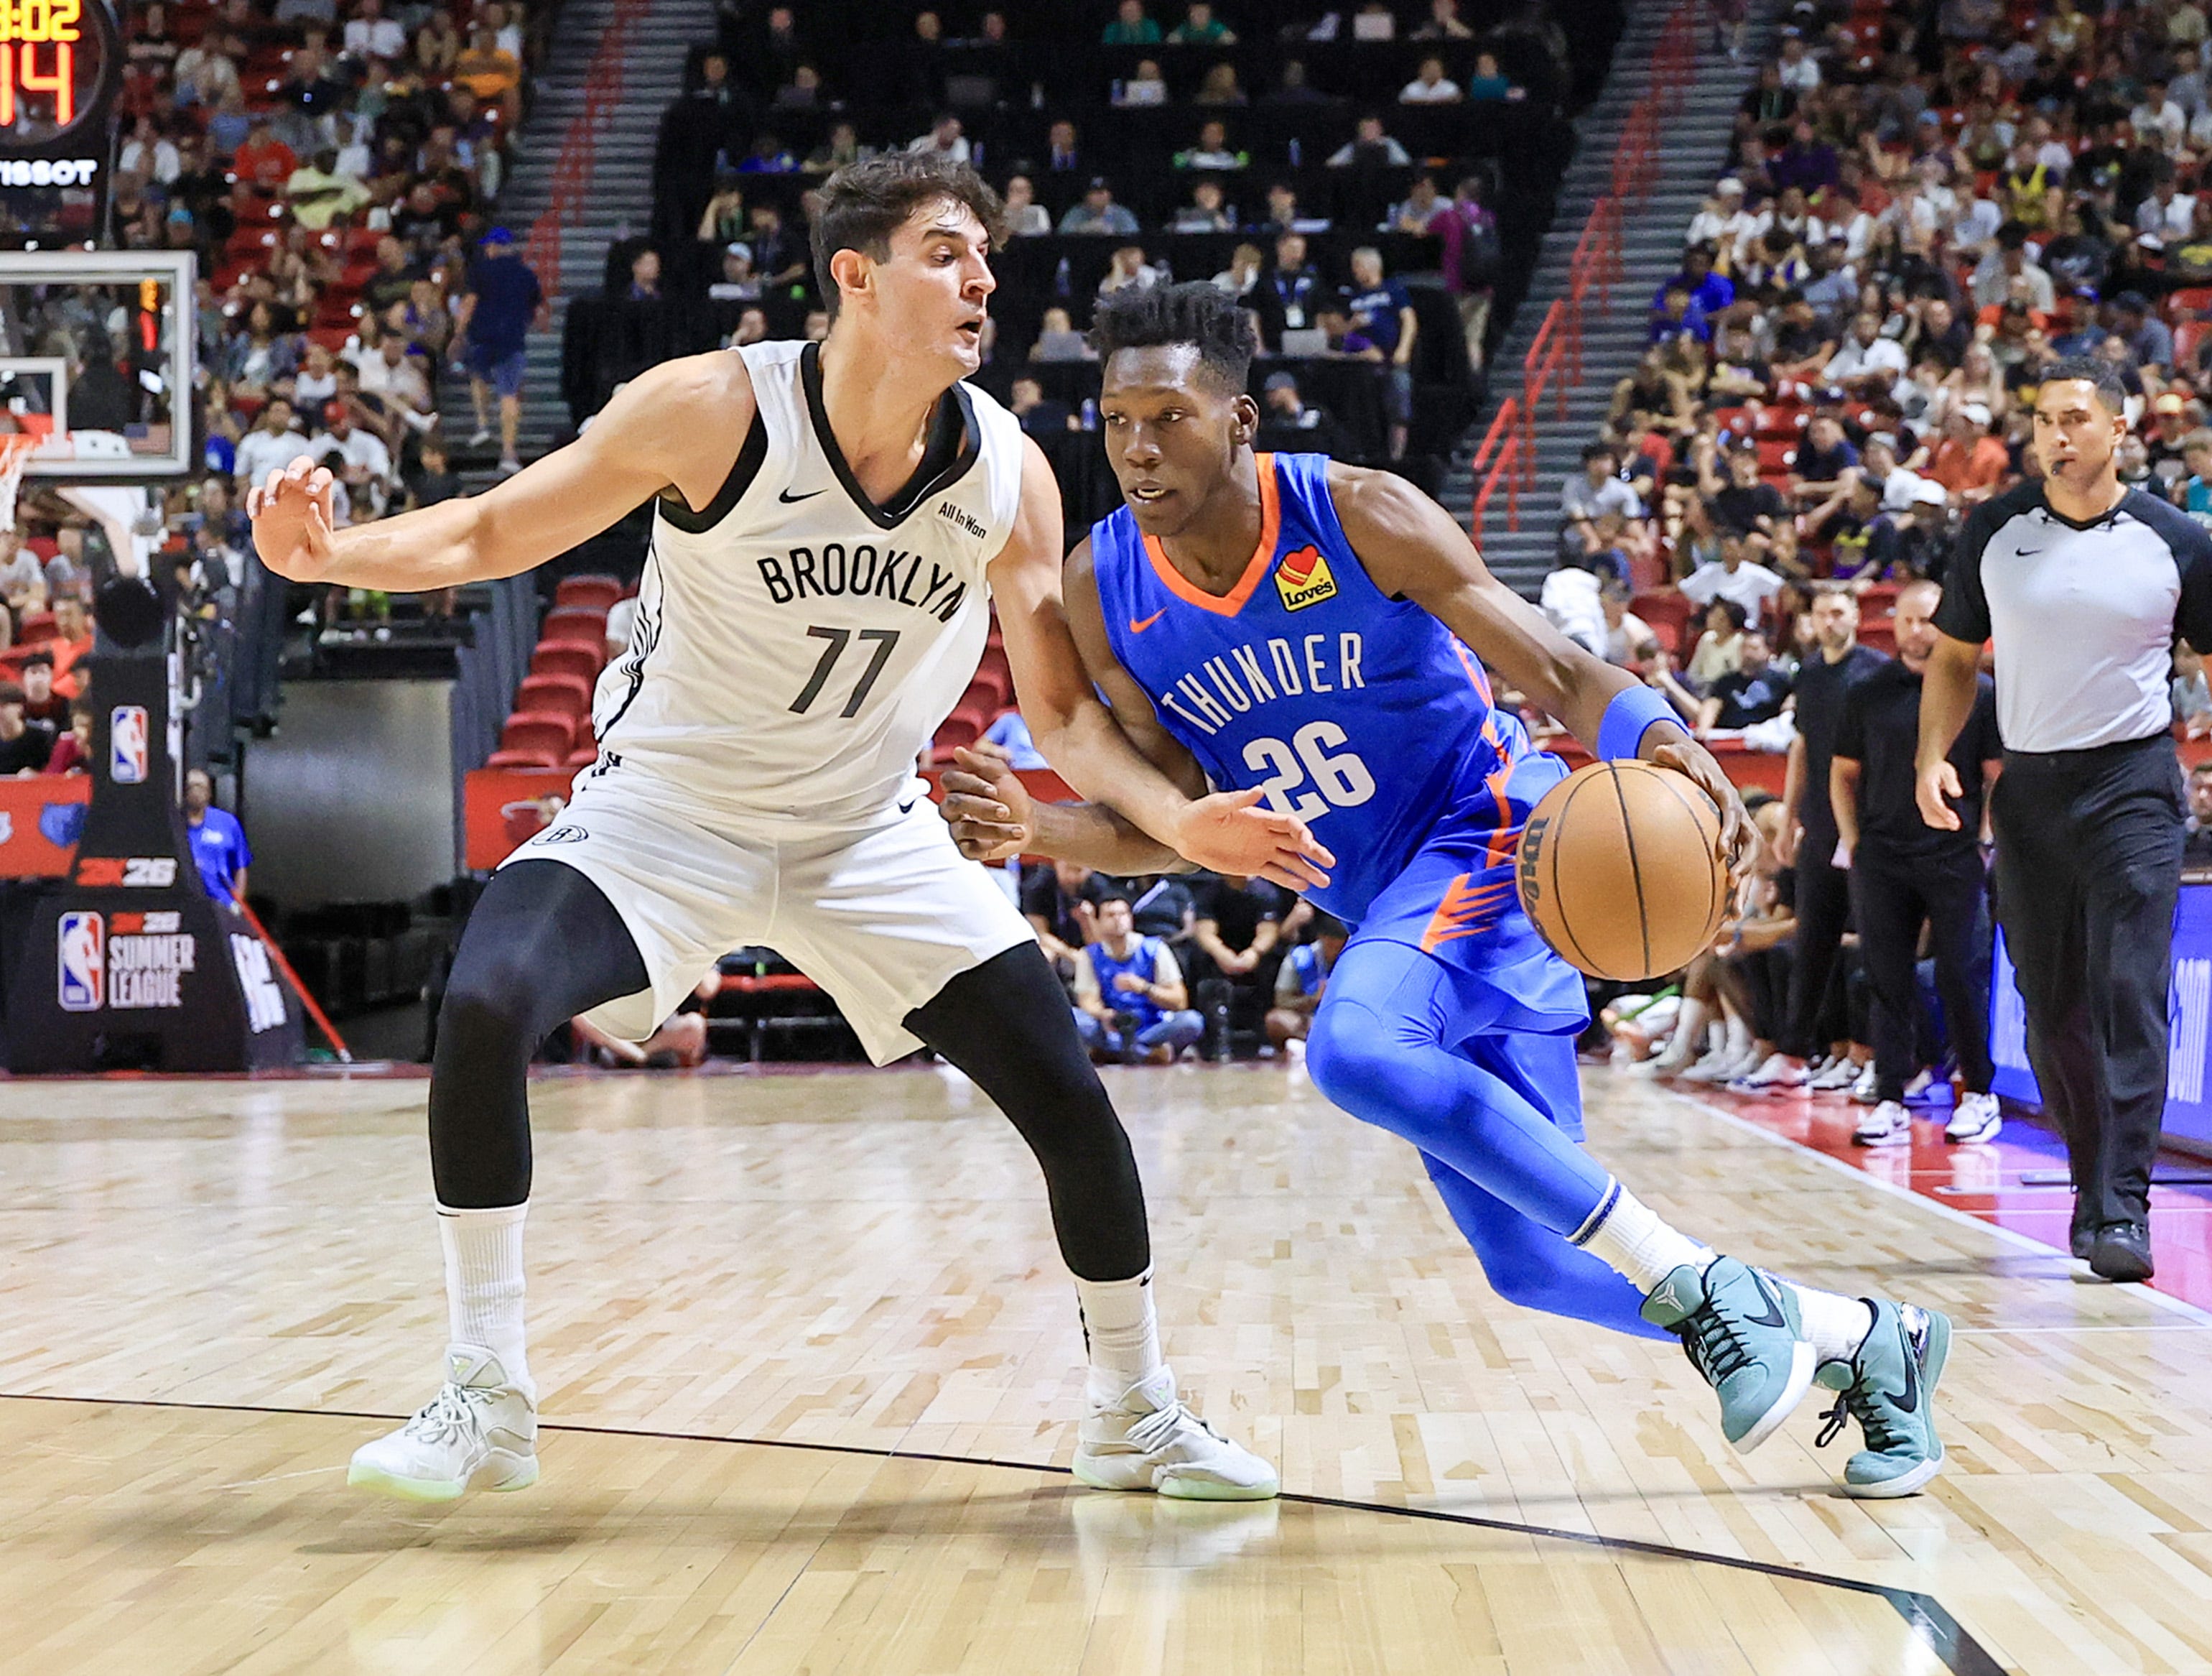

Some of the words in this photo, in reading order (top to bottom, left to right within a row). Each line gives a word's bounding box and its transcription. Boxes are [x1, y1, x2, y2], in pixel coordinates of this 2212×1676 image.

[0, 42, 74, 126] 14
[0, 159, 98, 186] ISSOT
[938, 501, 956, 519] All
[757, 543, 966, 623] BROOKLYN
[787, 626, 901, 718] 77
[1161, 632, 1365, 736] THUNDER
[1242, 721, 1376, 824] 26
[108, 934, 195, 971] SUMMER
[108, 969, 183, 1009] LEAGUE
